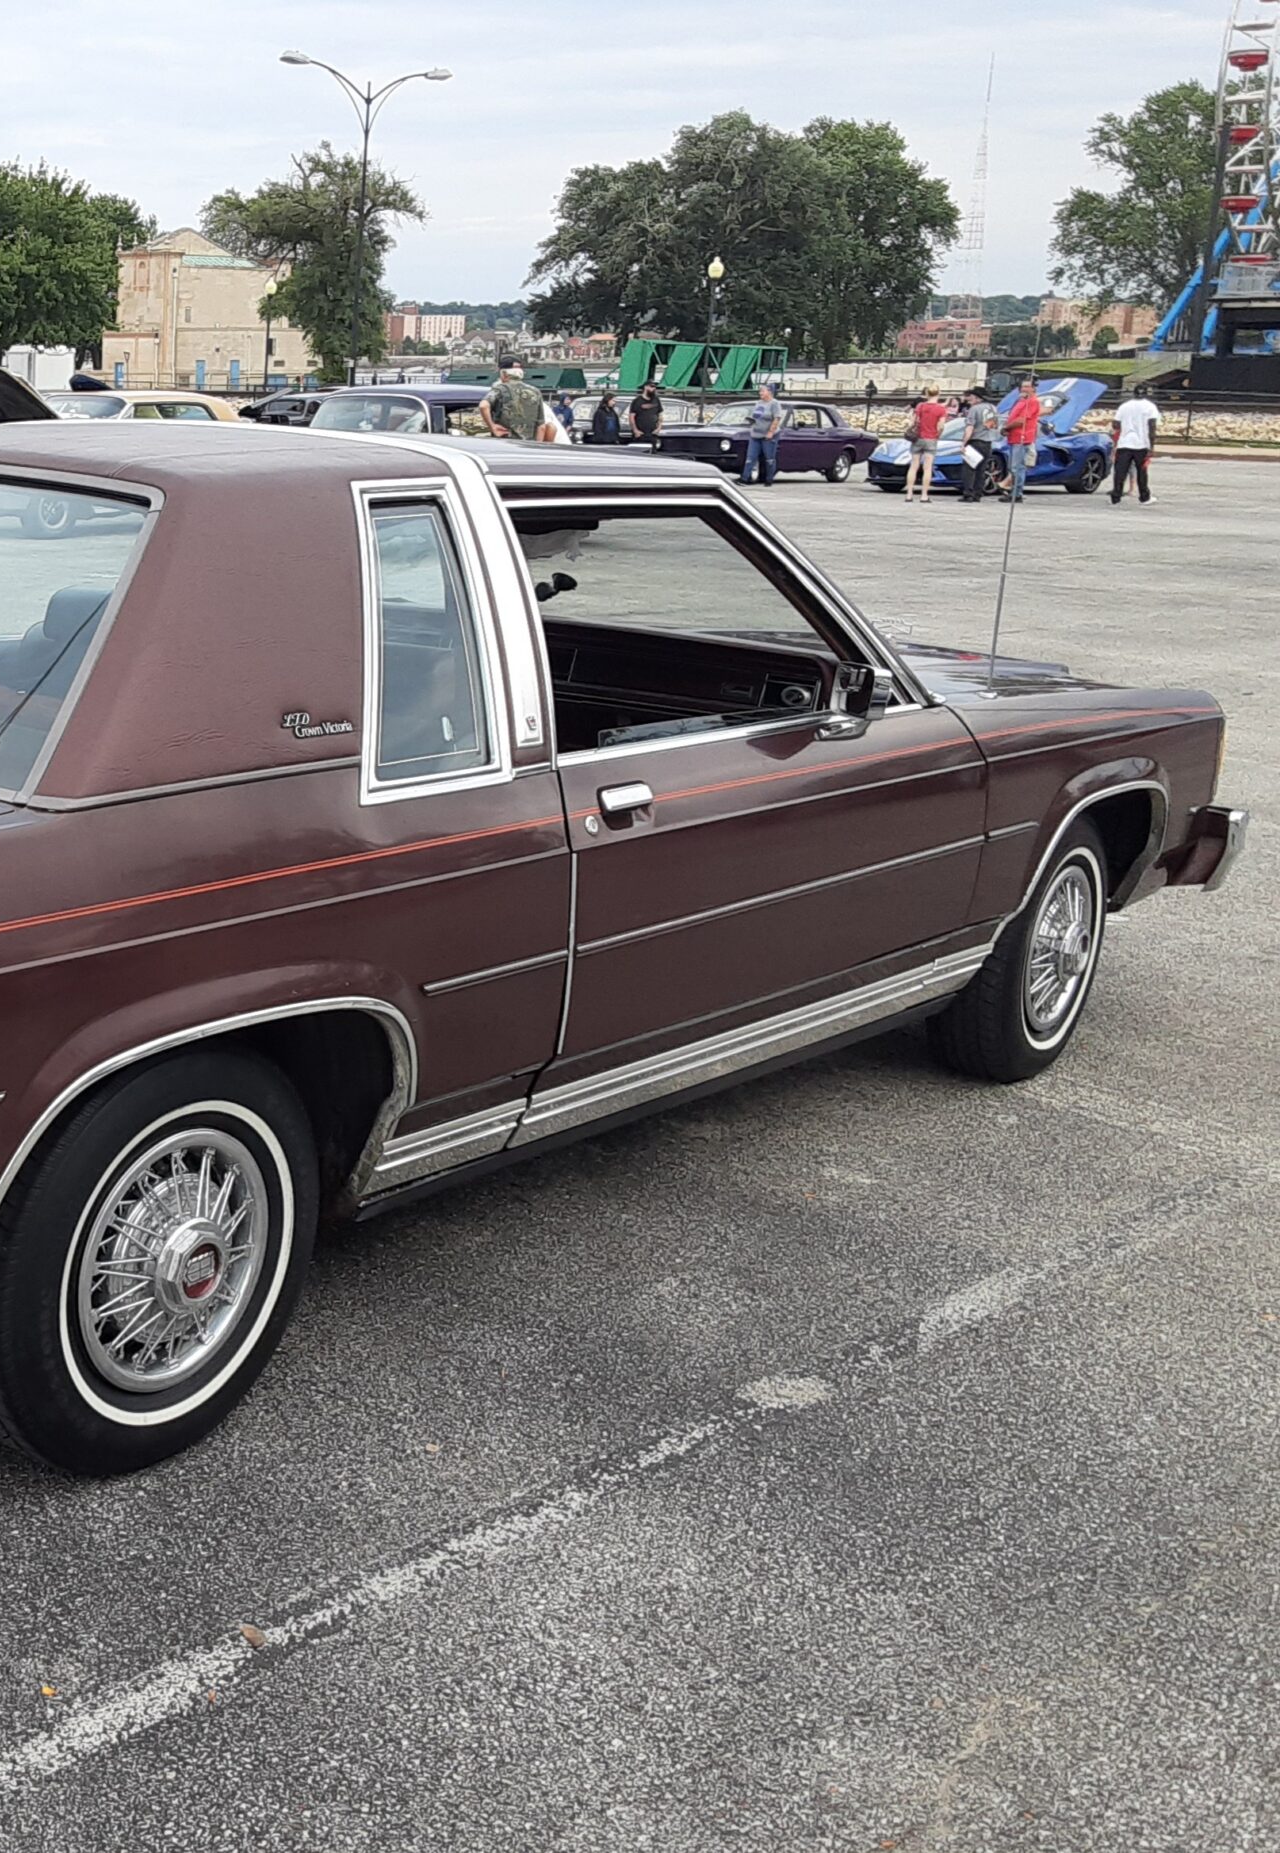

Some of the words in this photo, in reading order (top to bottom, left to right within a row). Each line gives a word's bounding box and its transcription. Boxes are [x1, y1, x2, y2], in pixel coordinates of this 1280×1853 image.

[282, 712, 310, 727] LTD
[295, 725, 323, 738] Crown
[322, 720, 353, 734] Victoria
